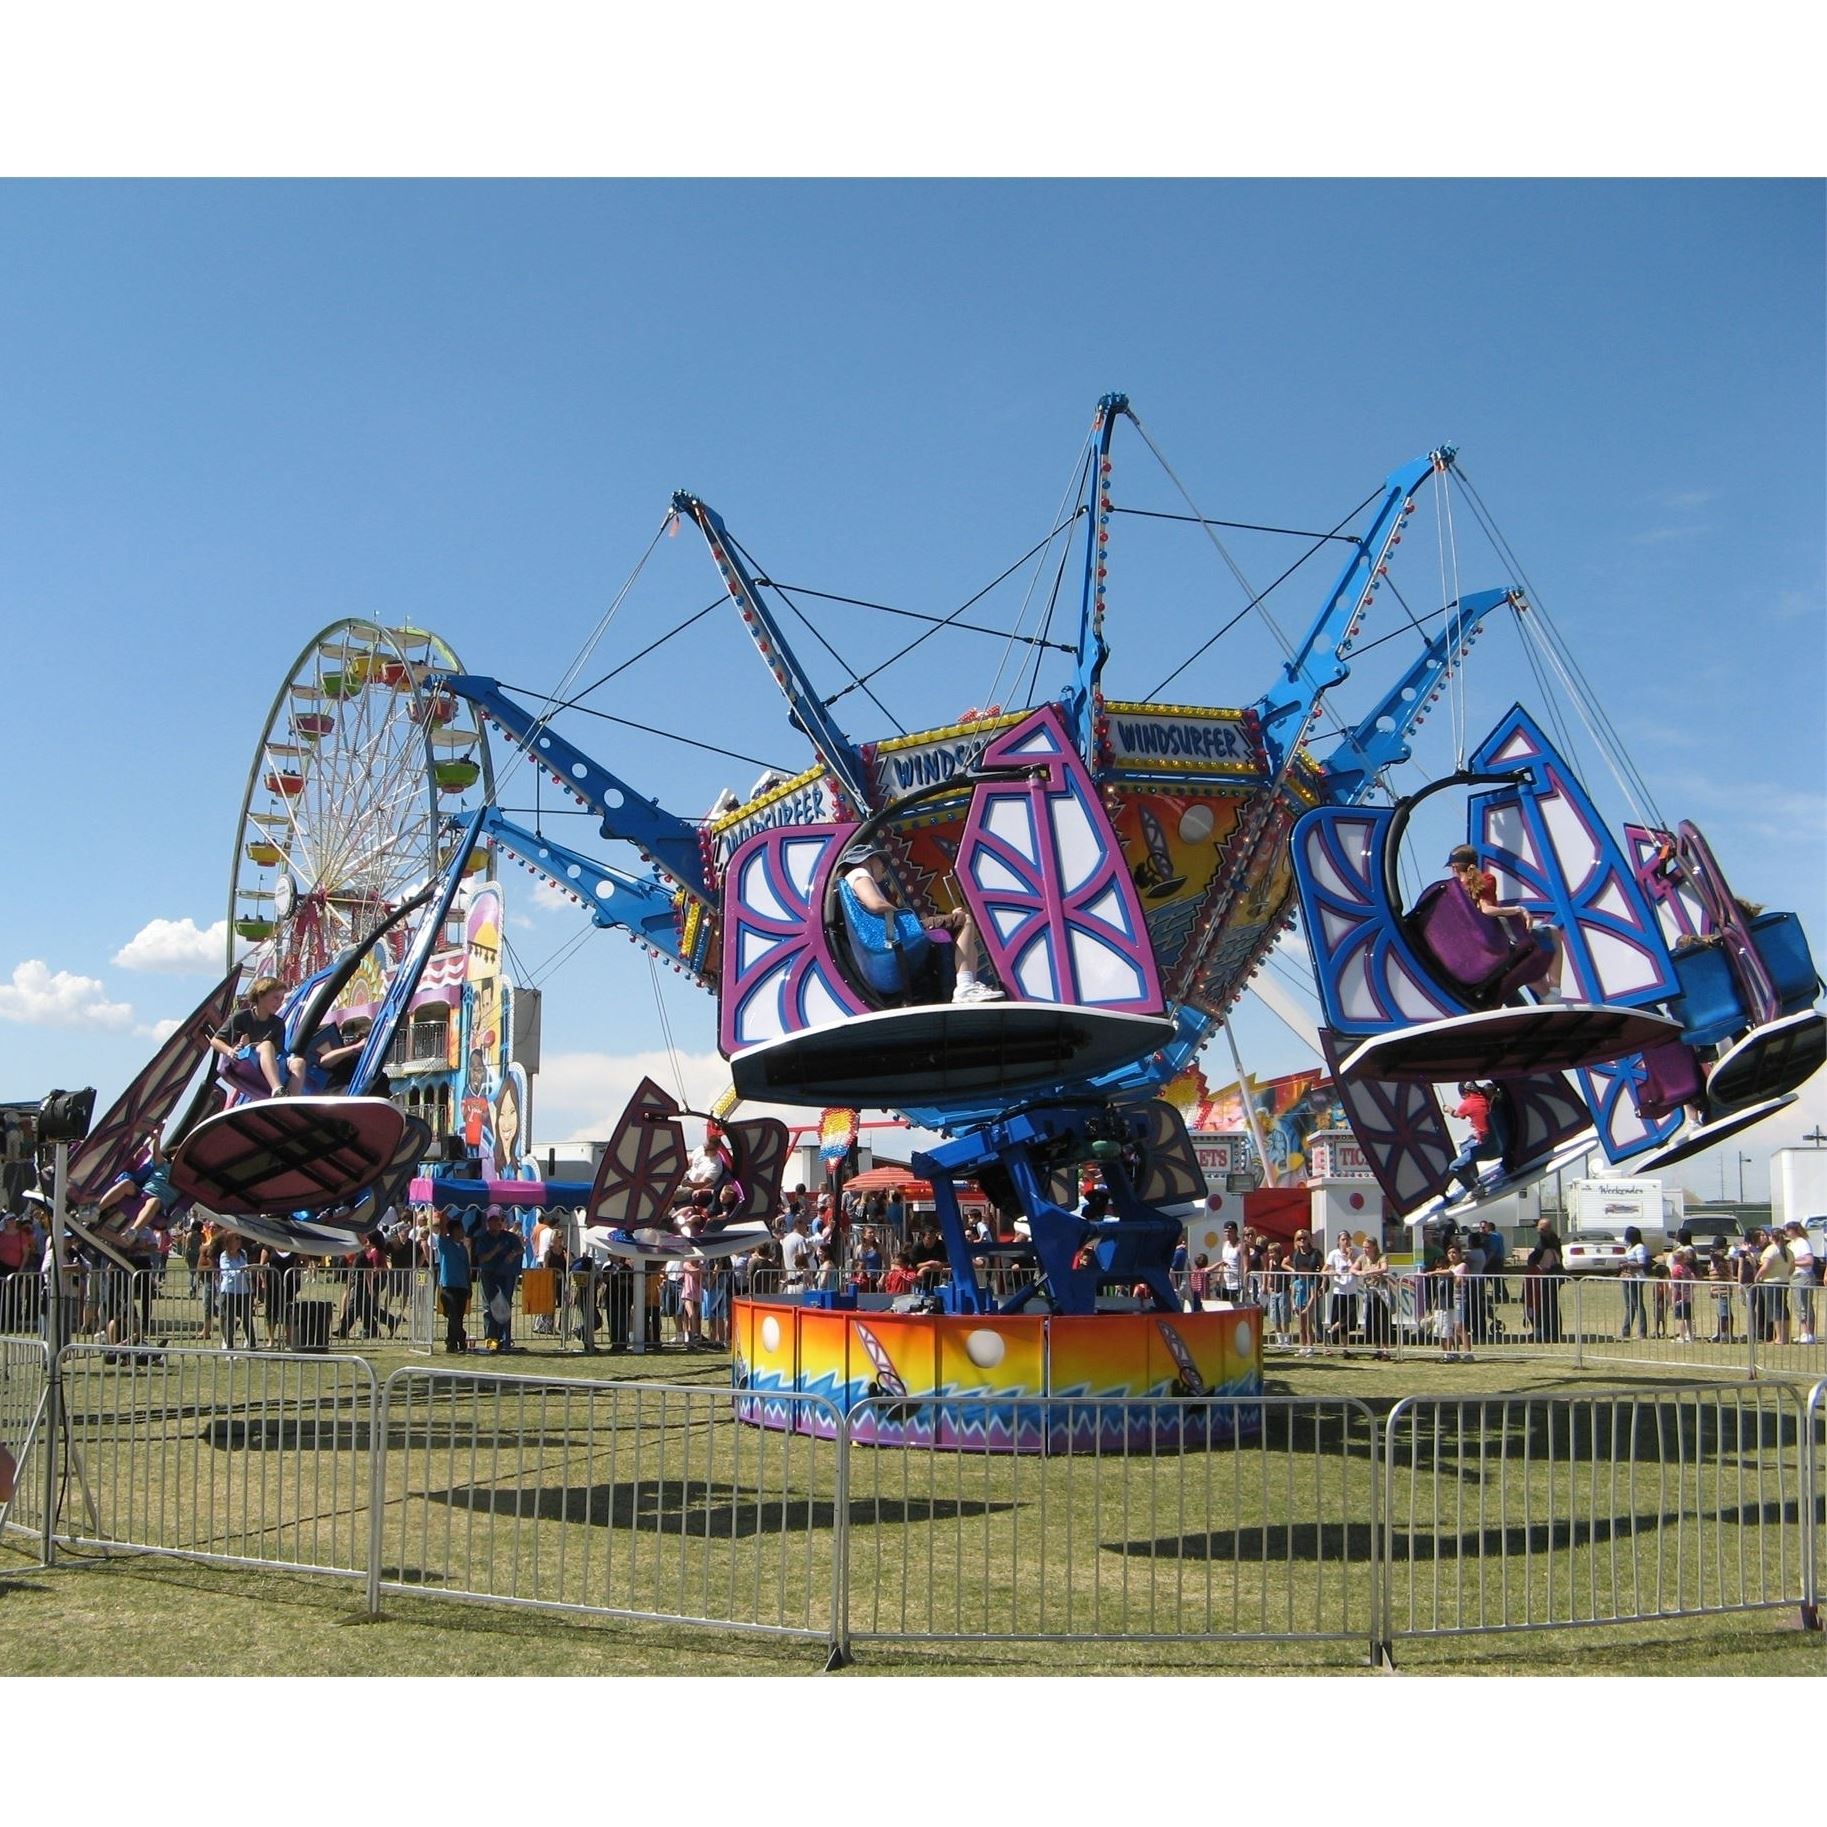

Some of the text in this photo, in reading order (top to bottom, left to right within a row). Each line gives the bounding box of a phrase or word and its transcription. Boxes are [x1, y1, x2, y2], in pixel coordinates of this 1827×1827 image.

[1117, 720, 1240, 758] WINDSURFER
[893, 738, 985, 790] WINDSU
[1195, 1149, 1227, 1167] ETS
[1340, 1147, 1368, 1166] TIC
